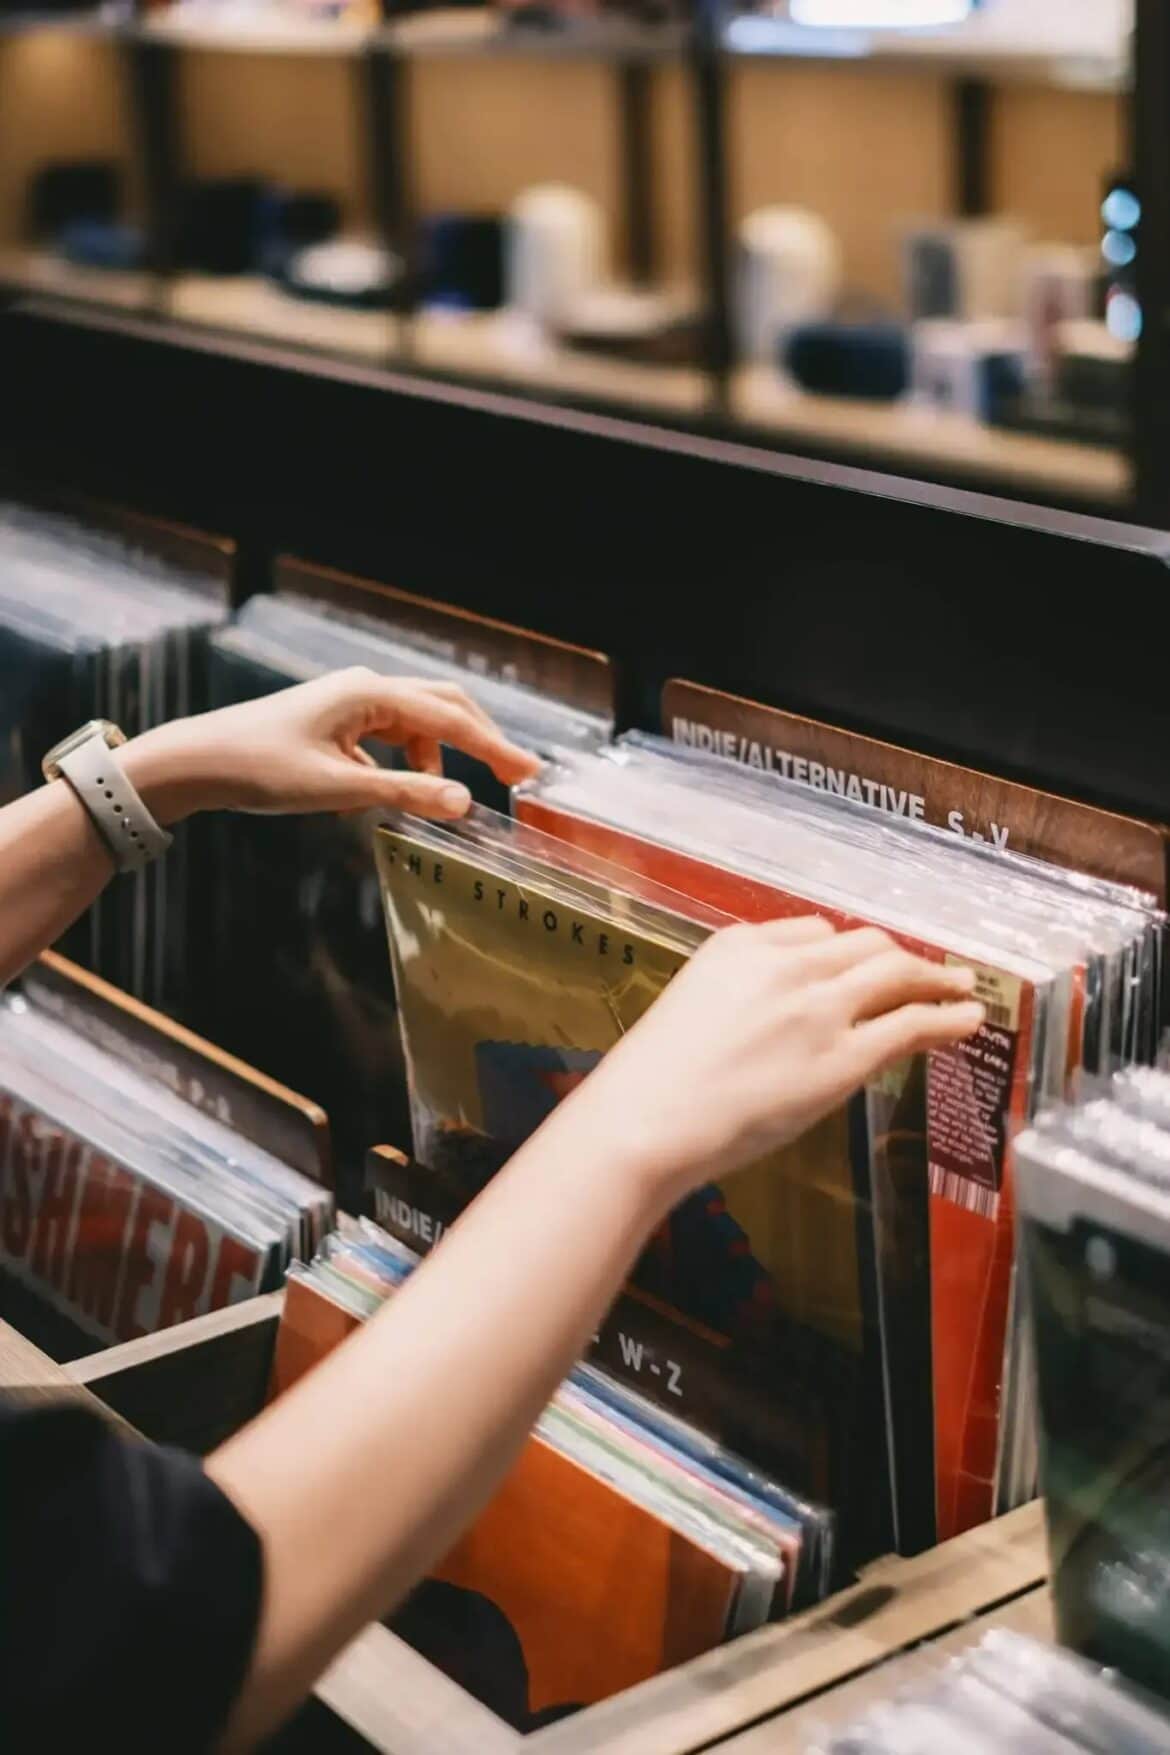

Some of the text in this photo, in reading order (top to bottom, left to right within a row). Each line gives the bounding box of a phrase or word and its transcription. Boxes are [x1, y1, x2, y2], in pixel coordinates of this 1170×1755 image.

[672, 717, 925, 822] INDIE/ALTERNATIVE
[474, 880, 634, 965] STROKES
[374, 1186, 446, 1246] INDIE/
